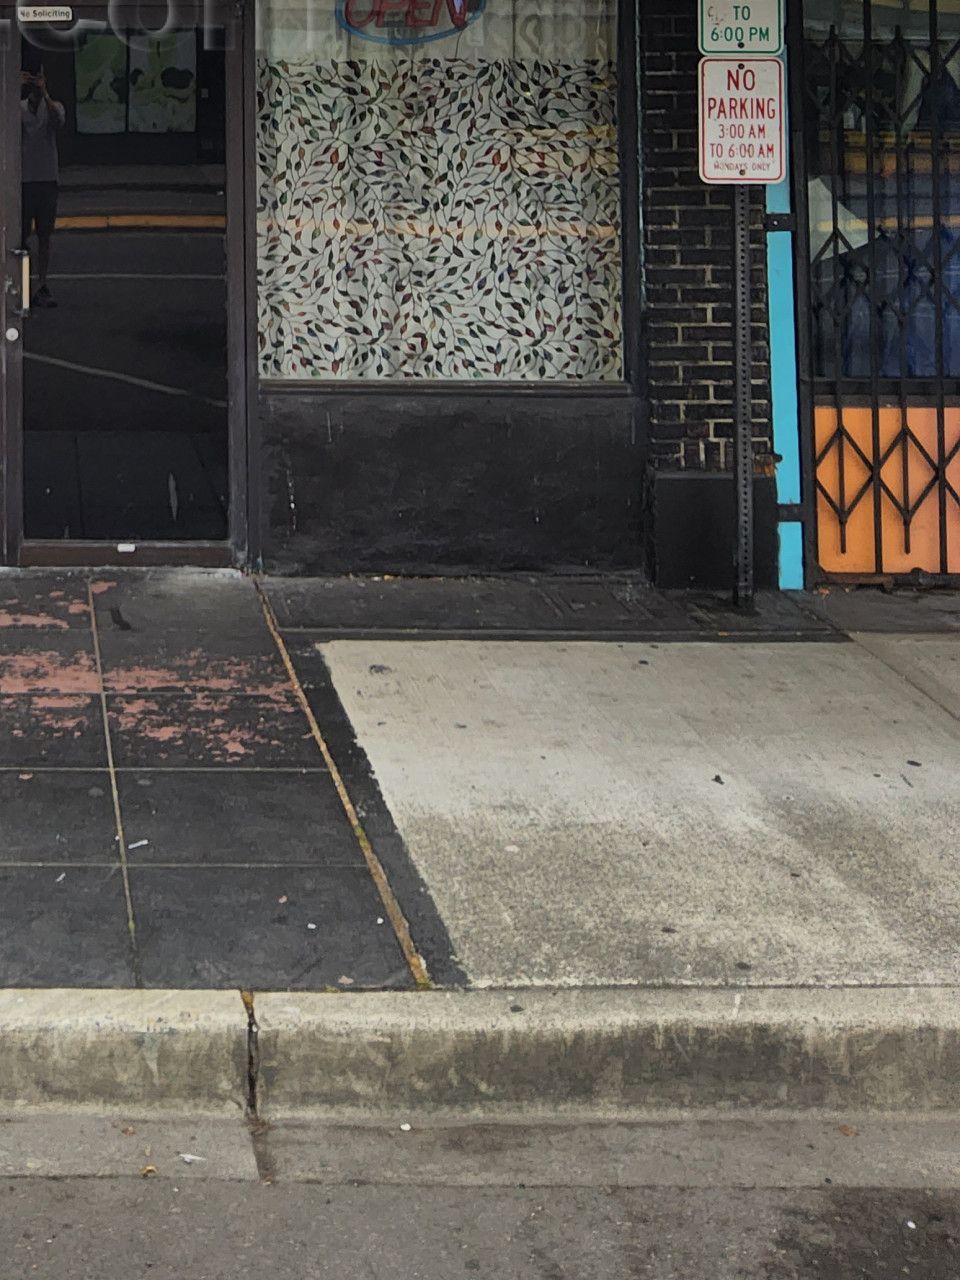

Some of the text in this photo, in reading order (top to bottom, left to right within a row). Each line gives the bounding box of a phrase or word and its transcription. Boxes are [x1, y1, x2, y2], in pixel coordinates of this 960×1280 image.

[32, 9, 71, 19] Soliciting
[733, 5, 751, 21] TO
[710, 27, 770, 42] 6:00 PM
[726, 69, 756, 91] NO
[707, 97, 776, 119] PARKING
[718, 123, 766, 139] 3:00 AM
[709, 143, 775, 158] TO 6:00 AM
